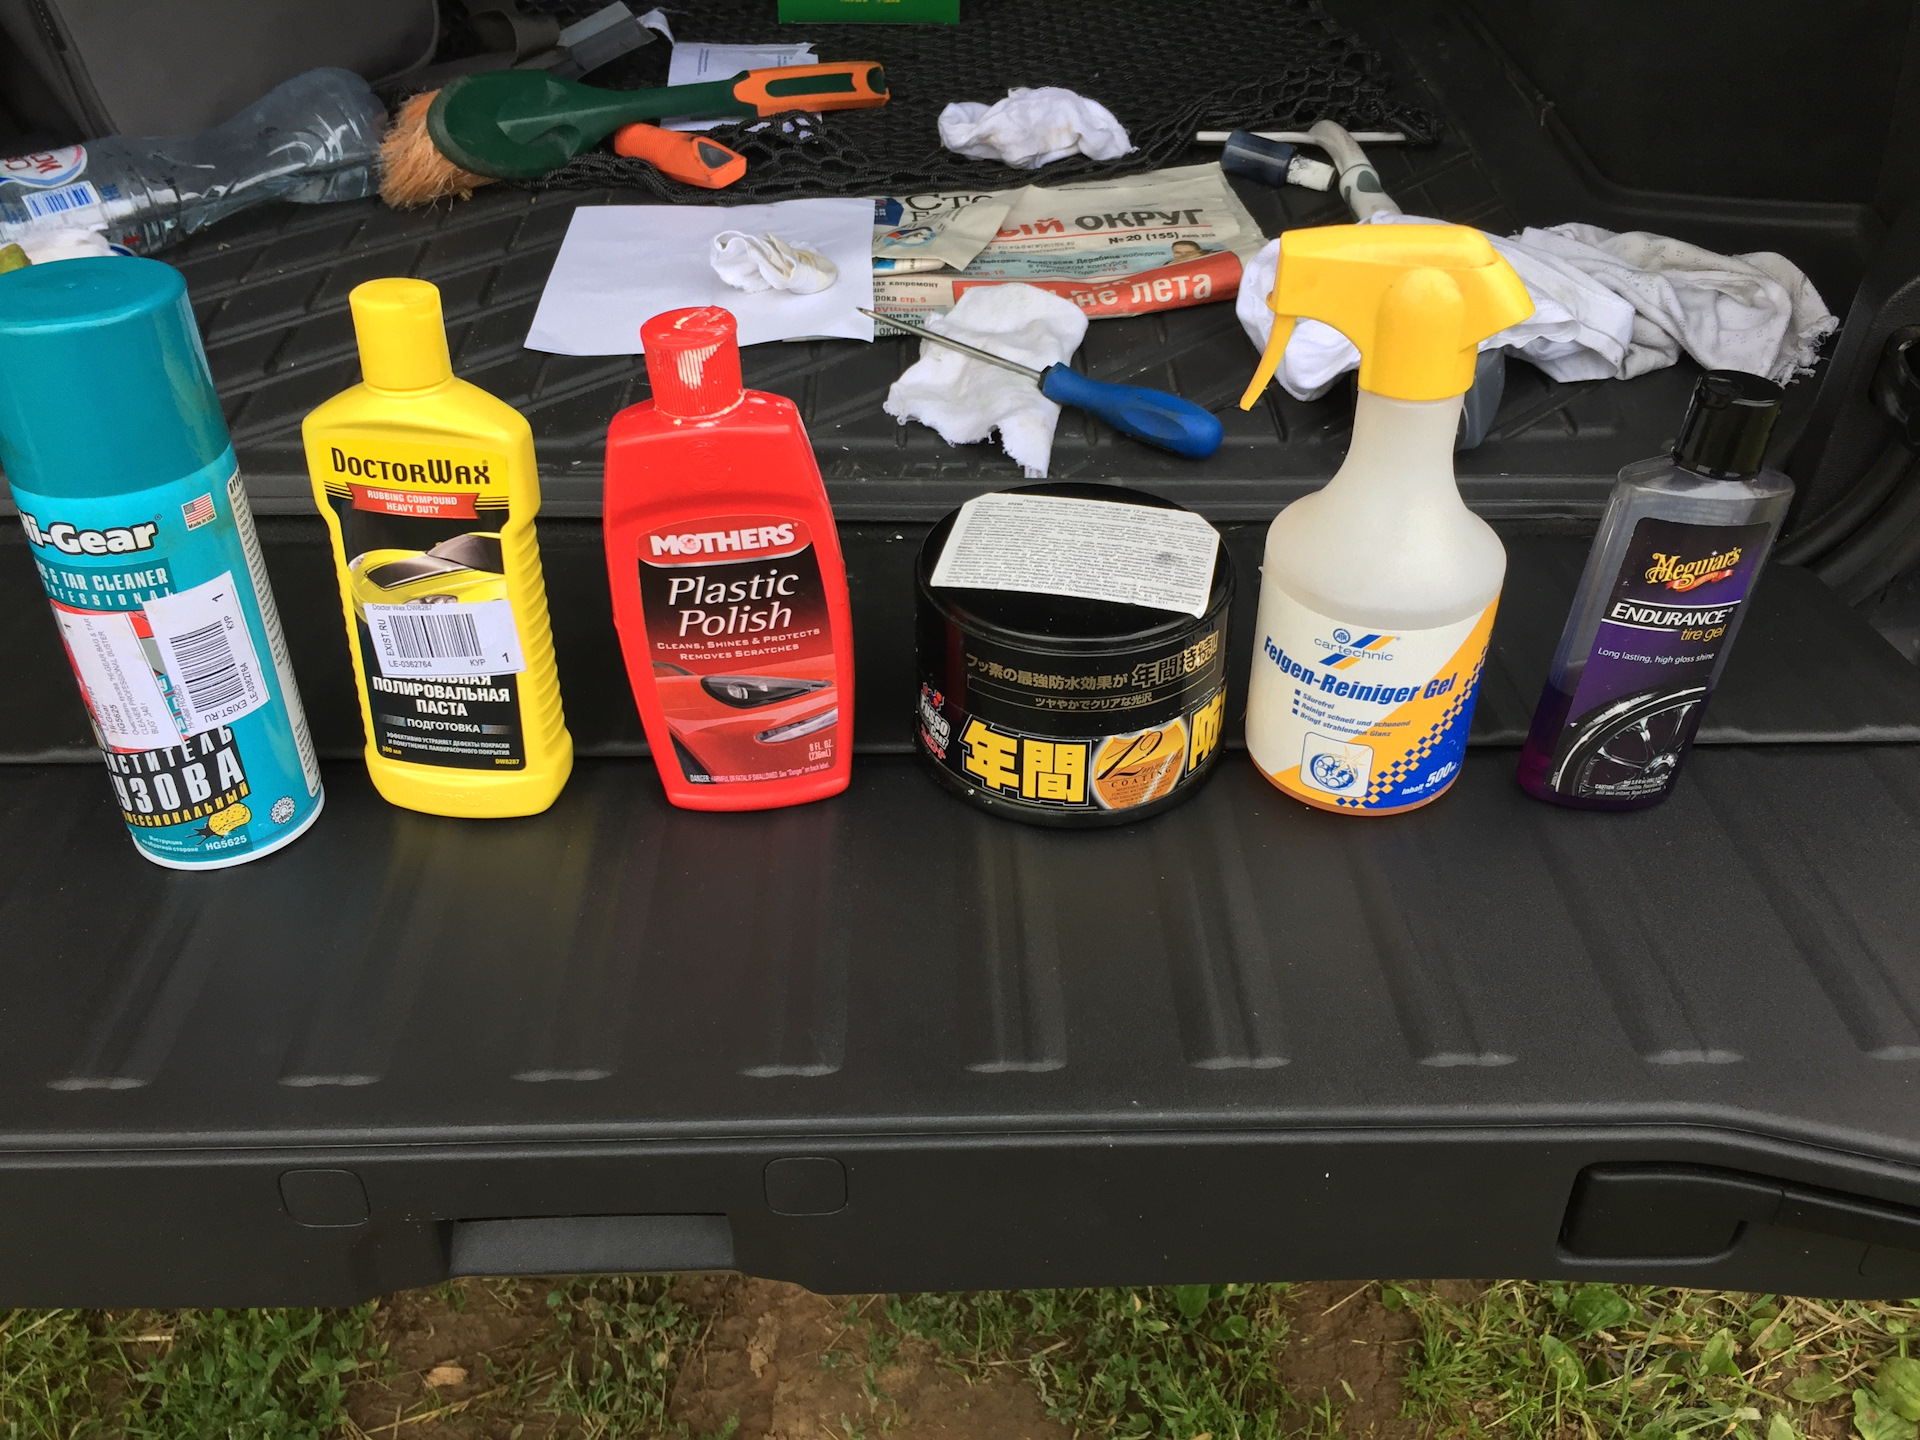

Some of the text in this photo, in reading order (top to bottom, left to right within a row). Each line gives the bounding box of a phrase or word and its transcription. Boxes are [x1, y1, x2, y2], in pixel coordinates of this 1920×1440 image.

[1075, 209, 1204, 231] ОКРУГ
[1146, 232, 1179, 241] (155)
[1077, 255, 1121, 264] Дерябина
[1131, 273, 1213, 304] лета
[367, 490, 457, 505] RUBBING COMPOUND
[386, 502, 439, 514] HEAVY DUTY
[19, 508, 158, 556] Hi-Gear
[650, 523, 795, 556] MOTHERS
[60, 571, 88, 591] TAR
[92, 567, 168, 592] CLEANER
[1645, 547, 1742, 590] Meguiar's
[210, 592, 225, 603] 1
[668, 568, 799, 605] Plastic
[679, 601, 792, 637] Polish
[1611, 602, 1728, 626] ENDURANCE
[378, 619, 395, 657] EXIST.RU
[657, 629, 820, 650] CLEANS, SHINES & PROTECTS
[1680, 624, 1726, 643] tire gel
[502, 653, 509, 663] 1
[735, 644, 799, 658] SCRATCHES
[1598, 648, 1715, 665] Long lasting, high gloss shine
[110, 657, 137, 705] PROFESSIONAL
[966, 652, 1128, 692] フッ素の最強防水効果が
[1264, 635, 1458, 705] Felgen-Reiniger Gel
[372, 676, 511, 702] ПОЛИРОВАЛЬНАЯ
[203, 698, 247, 724] EXIST.RU
[416, 699, 468, 717] ПАСТА
[1303, 693, 1335, 710] Säurefrei
[131, 704, 151, 735] CLEANER
[406, 718, 481, 733] ПОДГОТОВКА
[1300, 712, 1322, 725] Bringt
[1323, 721, 1367, 736] strahlenden
[1301, 703, 1411, 728] Reinigt schnell und schonend
[453, 740, 480, 748] ДЕФЕКТЫ
[478, 748, 510, 756] ПОКРЫТИЯ
[809, 743, 814, 752] 8
[963, 719, 1087, 803] 年間
[110, 746, 245, 814] УЗОВА
[1111, 768, 1171, 788] COATING
[1401, 783, 1424, 795] Inhalt
[205, 836, 247, 851] HG5625
